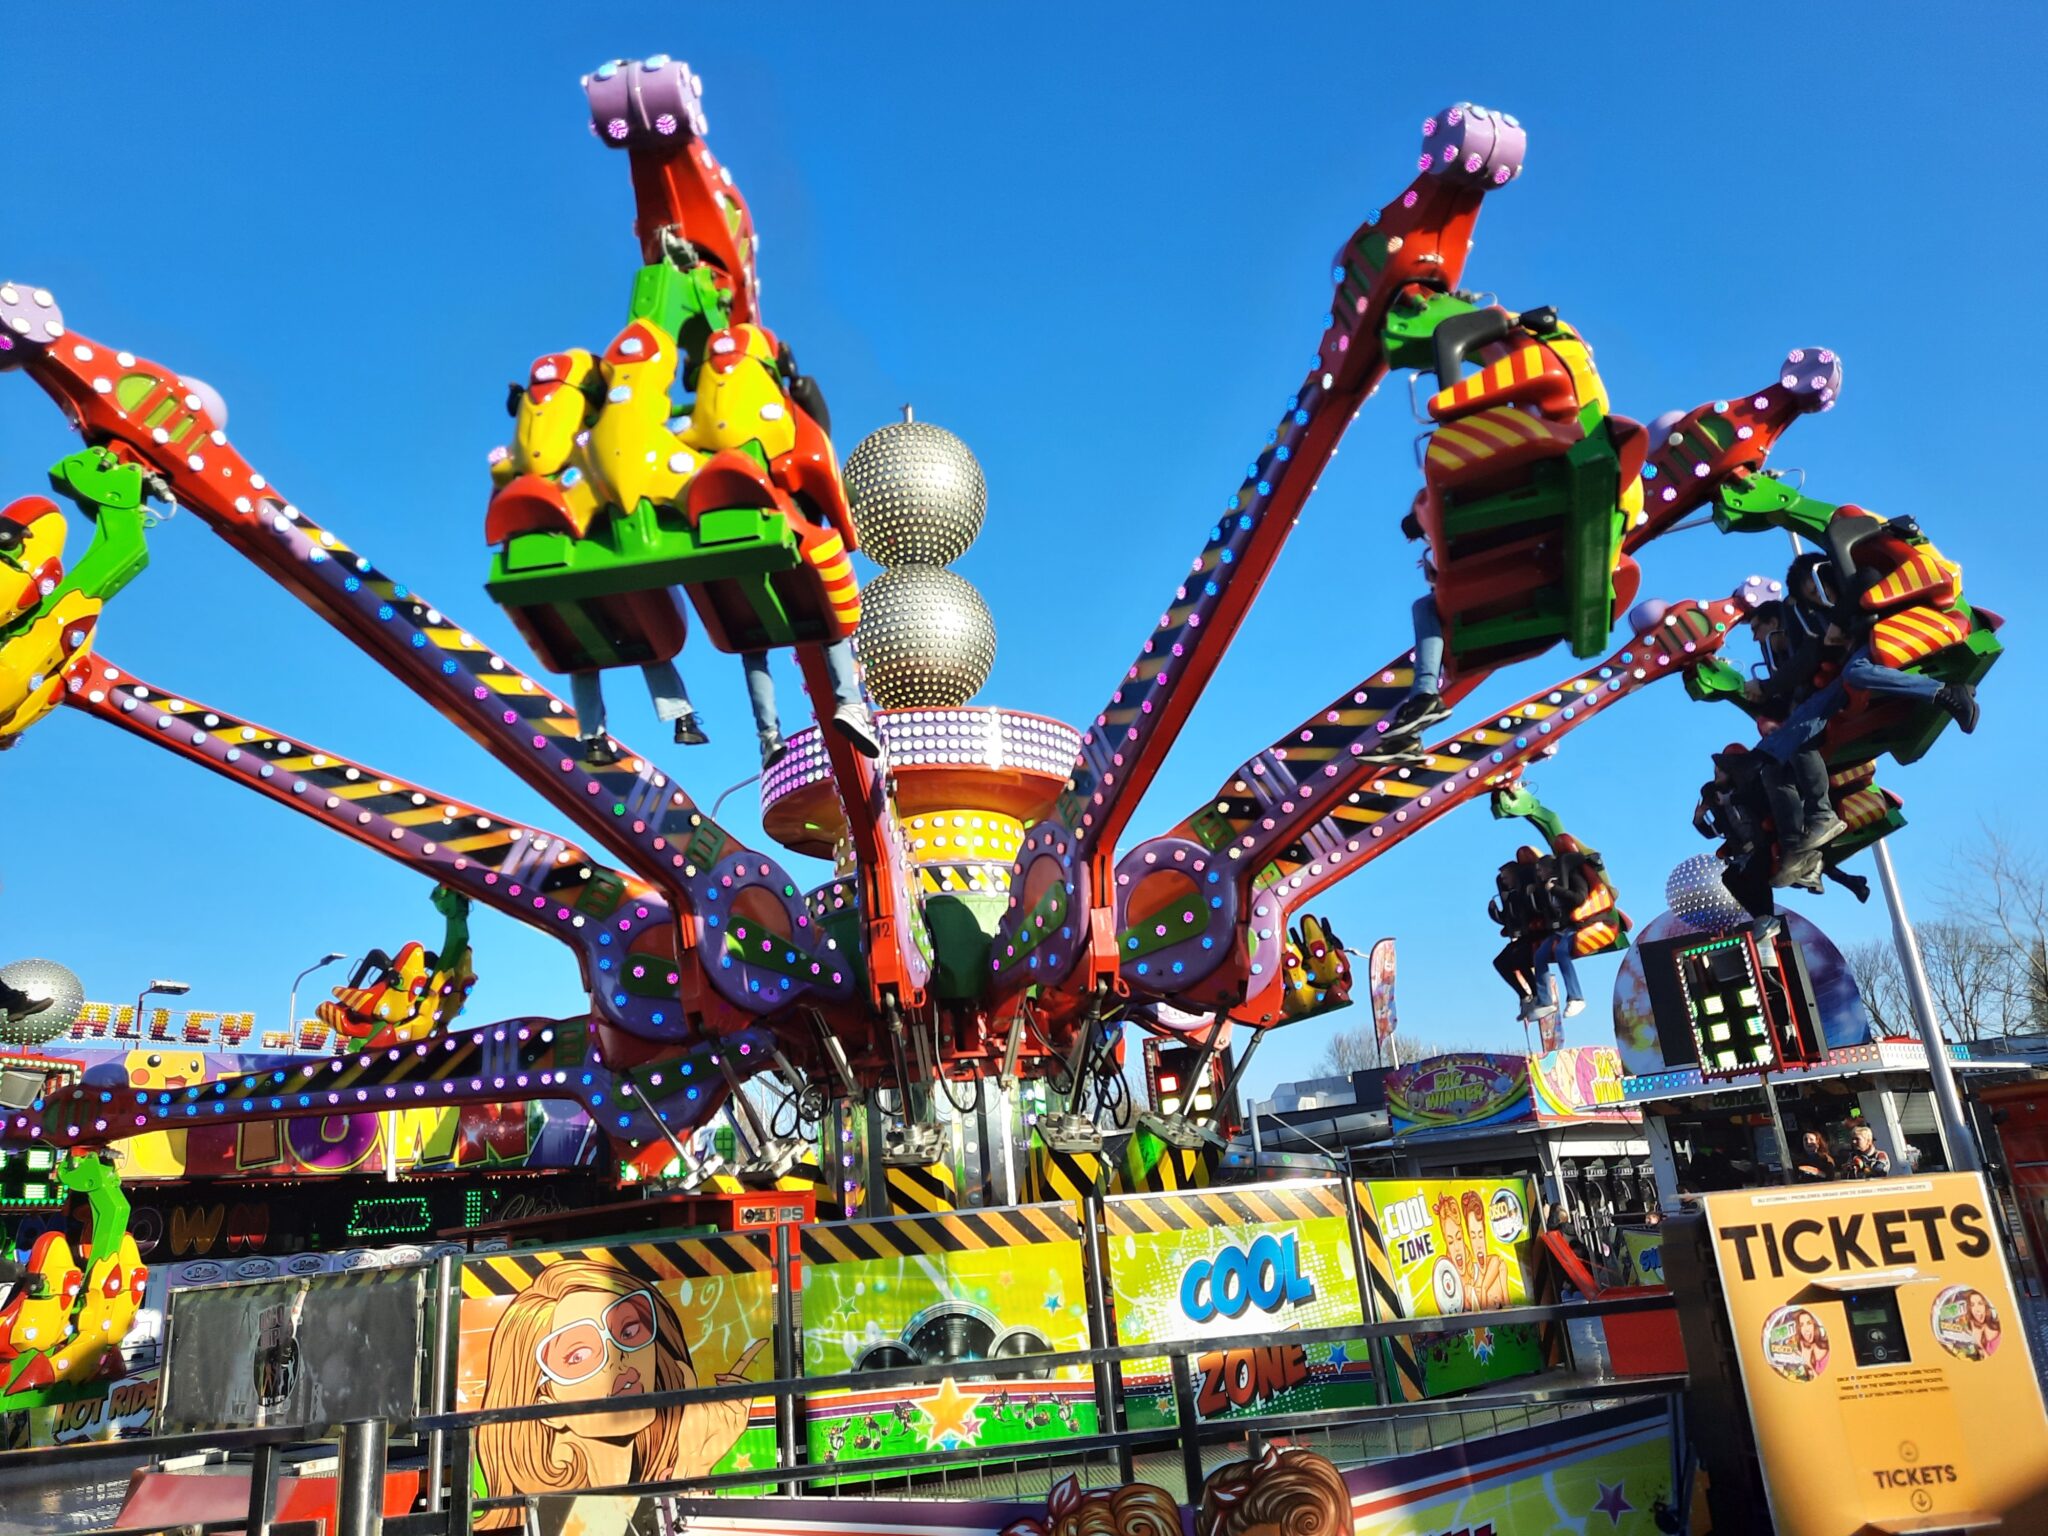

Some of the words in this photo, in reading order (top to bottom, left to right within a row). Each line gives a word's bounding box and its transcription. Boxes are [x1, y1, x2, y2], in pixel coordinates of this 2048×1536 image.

[876, 922, 892, 938] 12
[1425, 1083, 1485, 1109] WINNER
[1434, 1070, 1464, 1090] BIG
[1383, 1195, 1433, 1239] COOL
[1398, 1233, 1434, 1265] ZONE
[1719, 1204, 1991, 1281] TICKETS
[1180, 1232, 1316, 1323] COOL
[1198, 1325, 1308, 1416] ZONE
[52, 1399, 105, 1434] HOT
[1873, 1464, 1957, 1489] TICKETS
